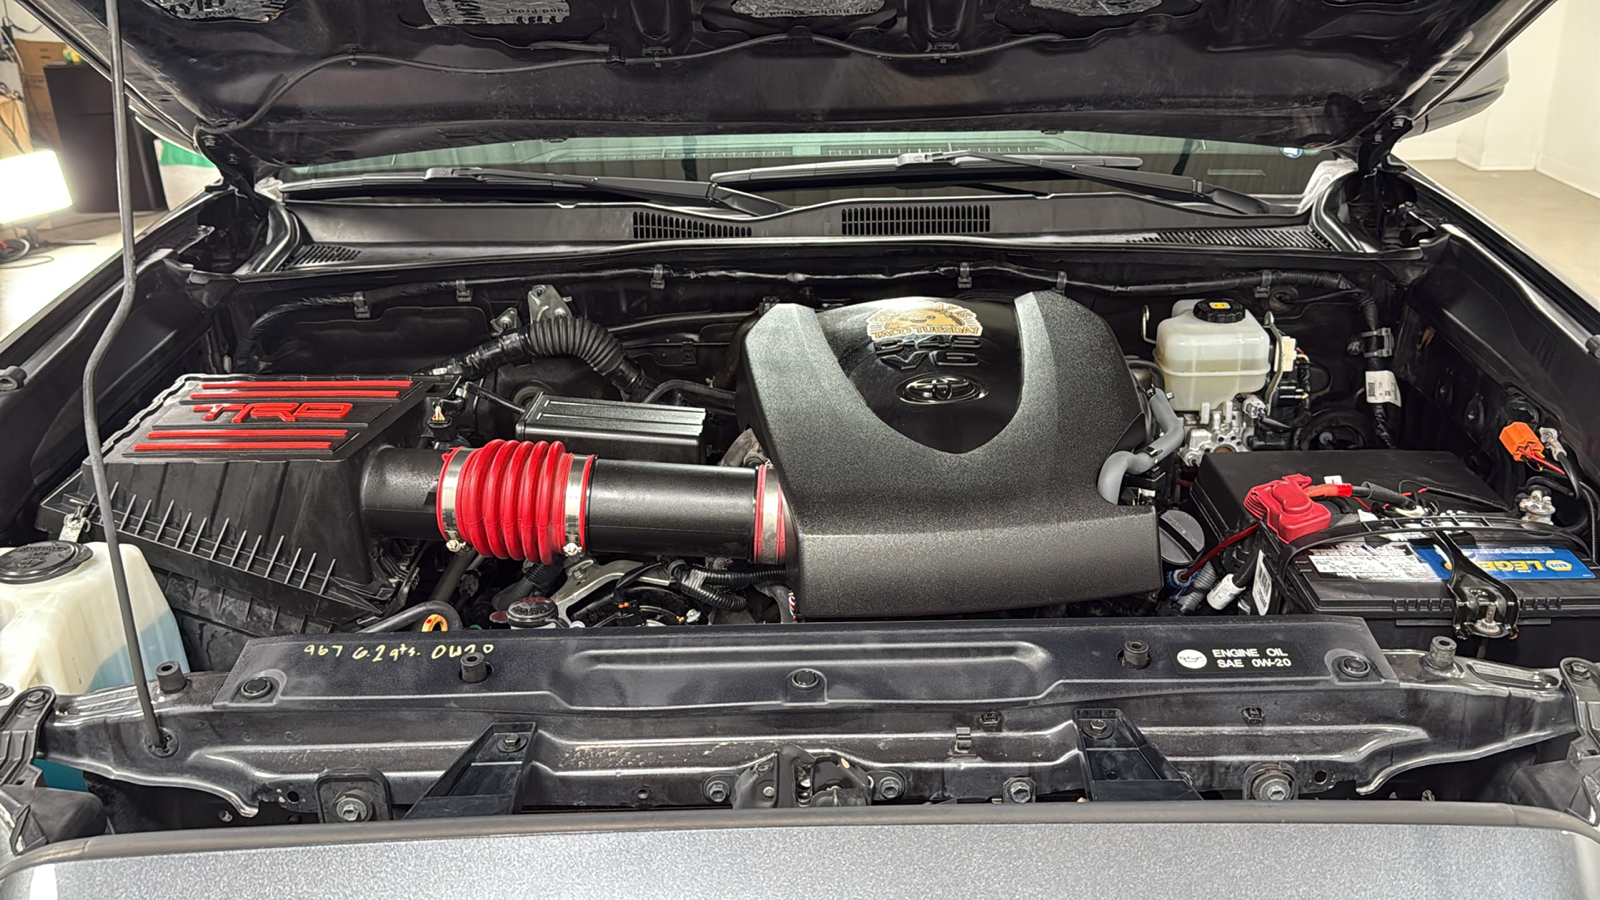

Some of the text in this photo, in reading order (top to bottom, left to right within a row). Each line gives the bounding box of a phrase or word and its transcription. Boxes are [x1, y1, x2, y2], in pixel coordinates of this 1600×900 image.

[871, 325, 980, 339] TACO TUESDAY
[193, 403, 353, 423] TRD
[352, 644, 386, 662] 6.2
[1212, 647, 1288, 658] ENGINE OIL
[1217, 659, 1244, 668] SAE
